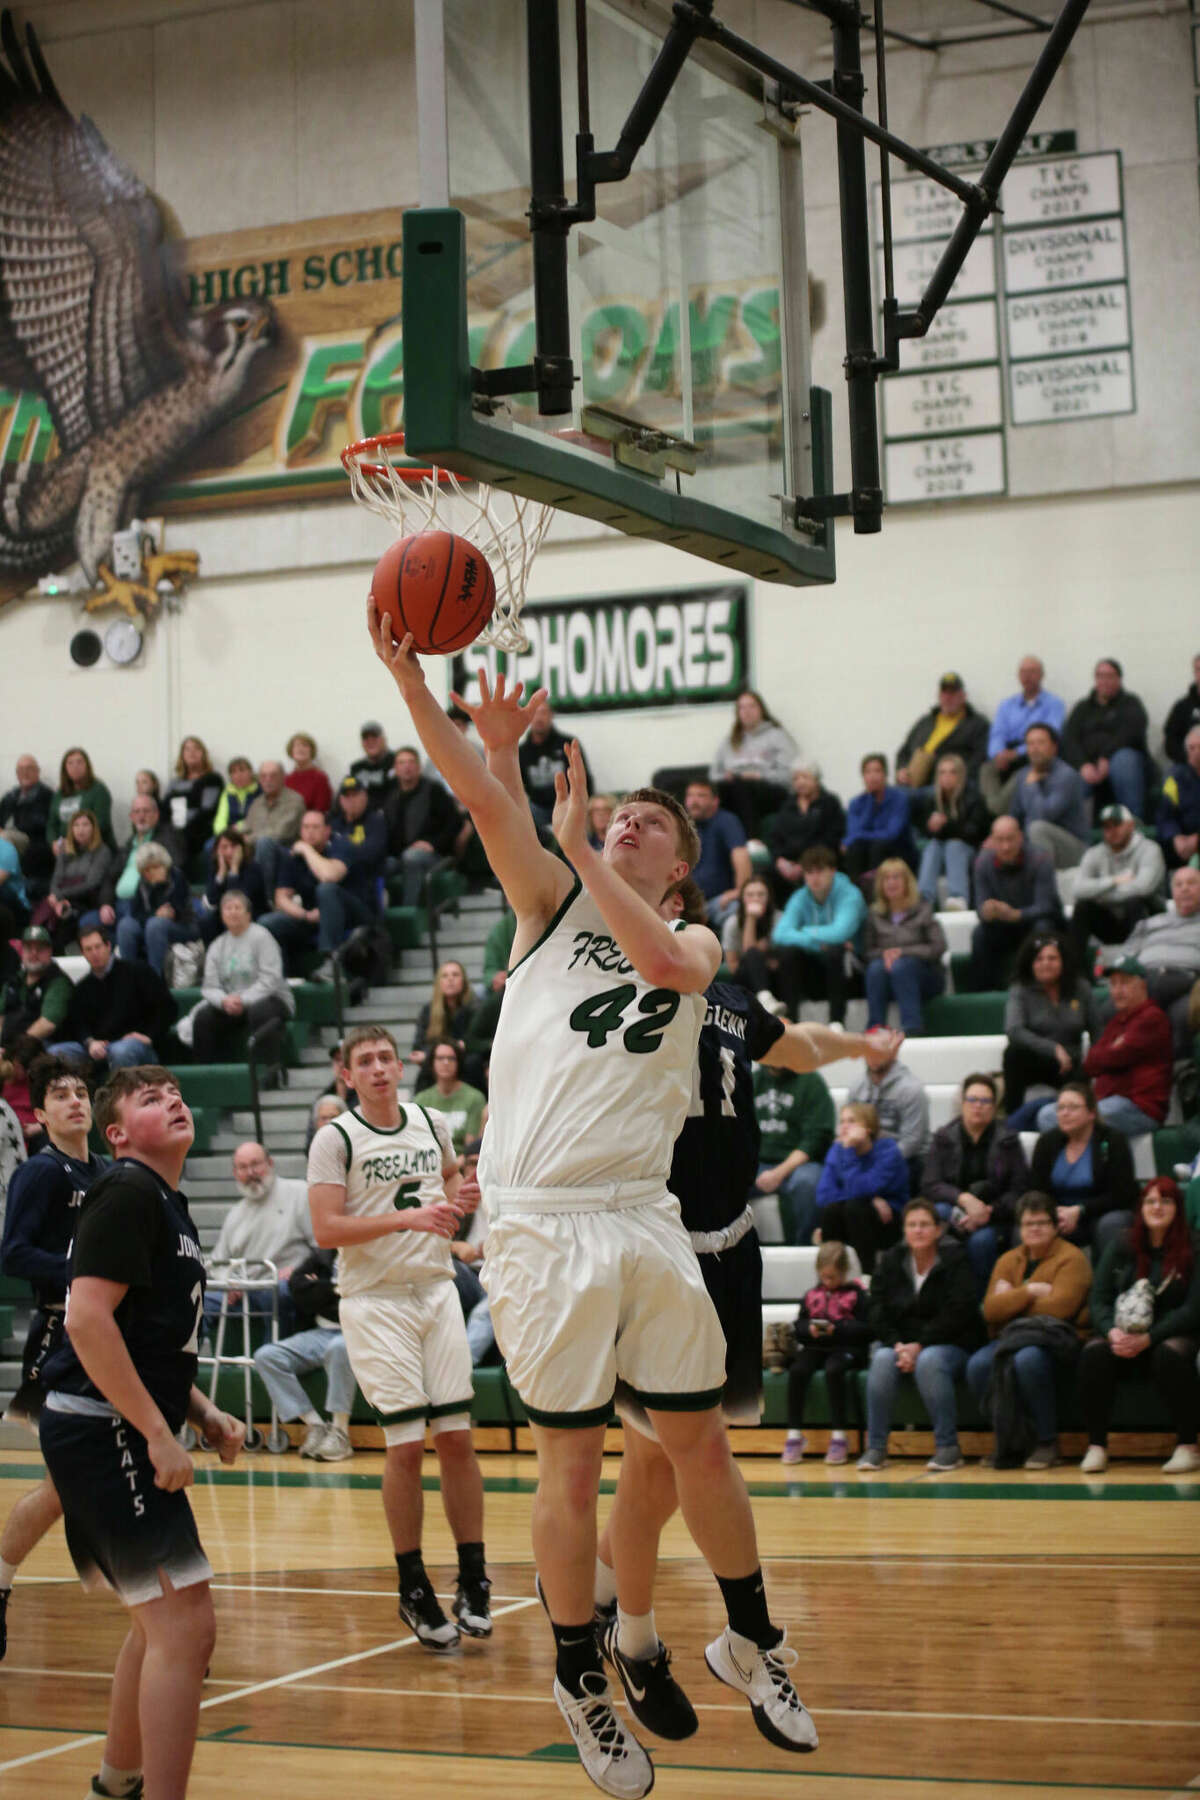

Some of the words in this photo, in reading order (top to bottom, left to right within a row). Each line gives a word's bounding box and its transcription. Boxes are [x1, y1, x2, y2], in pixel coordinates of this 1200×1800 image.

[1008, 226, 1117, 255] DIVISIONAL
[187, 259, 290, 307] HIGH
[1012, 292, 1121, 321] DIVISIONAL
[1016, 359, 1123, 387] DIVISIONAL
[463, 600, 734, 705] SOPHOMORES
[569, 983, 681, 1055] 42
[362, 1148, 438, 1189] FREELAND
[393, 1181, 422, 1232] 5
